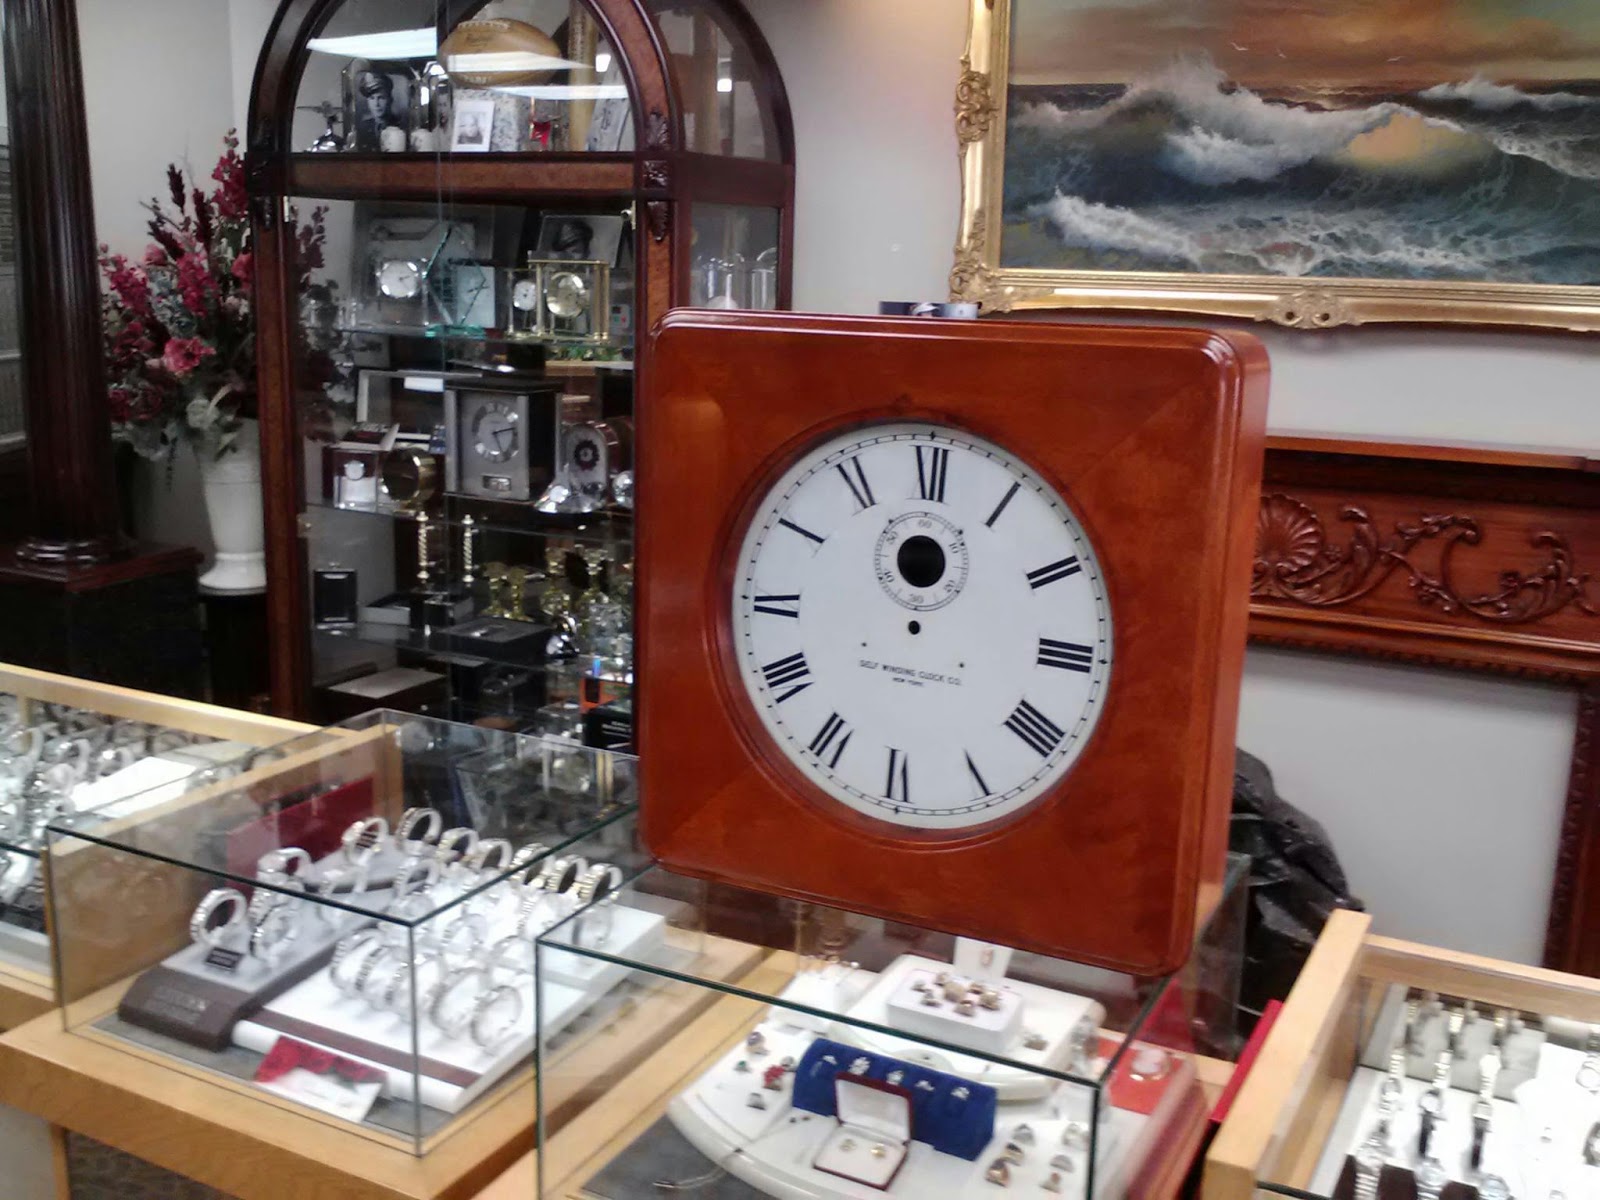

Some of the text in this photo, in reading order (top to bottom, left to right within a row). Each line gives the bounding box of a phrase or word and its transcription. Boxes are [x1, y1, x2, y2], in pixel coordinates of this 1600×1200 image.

[835, 454, 878, 515] XI
[910, 445, 952, 503] XII
[982, 480, 1022, 531] I
[1025, 554, 1083, 590] II
[882, 664, 916, 677] WINDING
[918, 670, 945, 683] CLOCK
[1036, 636, 1094, 674] III
[1002, 698, 1066, 759] IIII
[882, 746, 915, 804] VI
